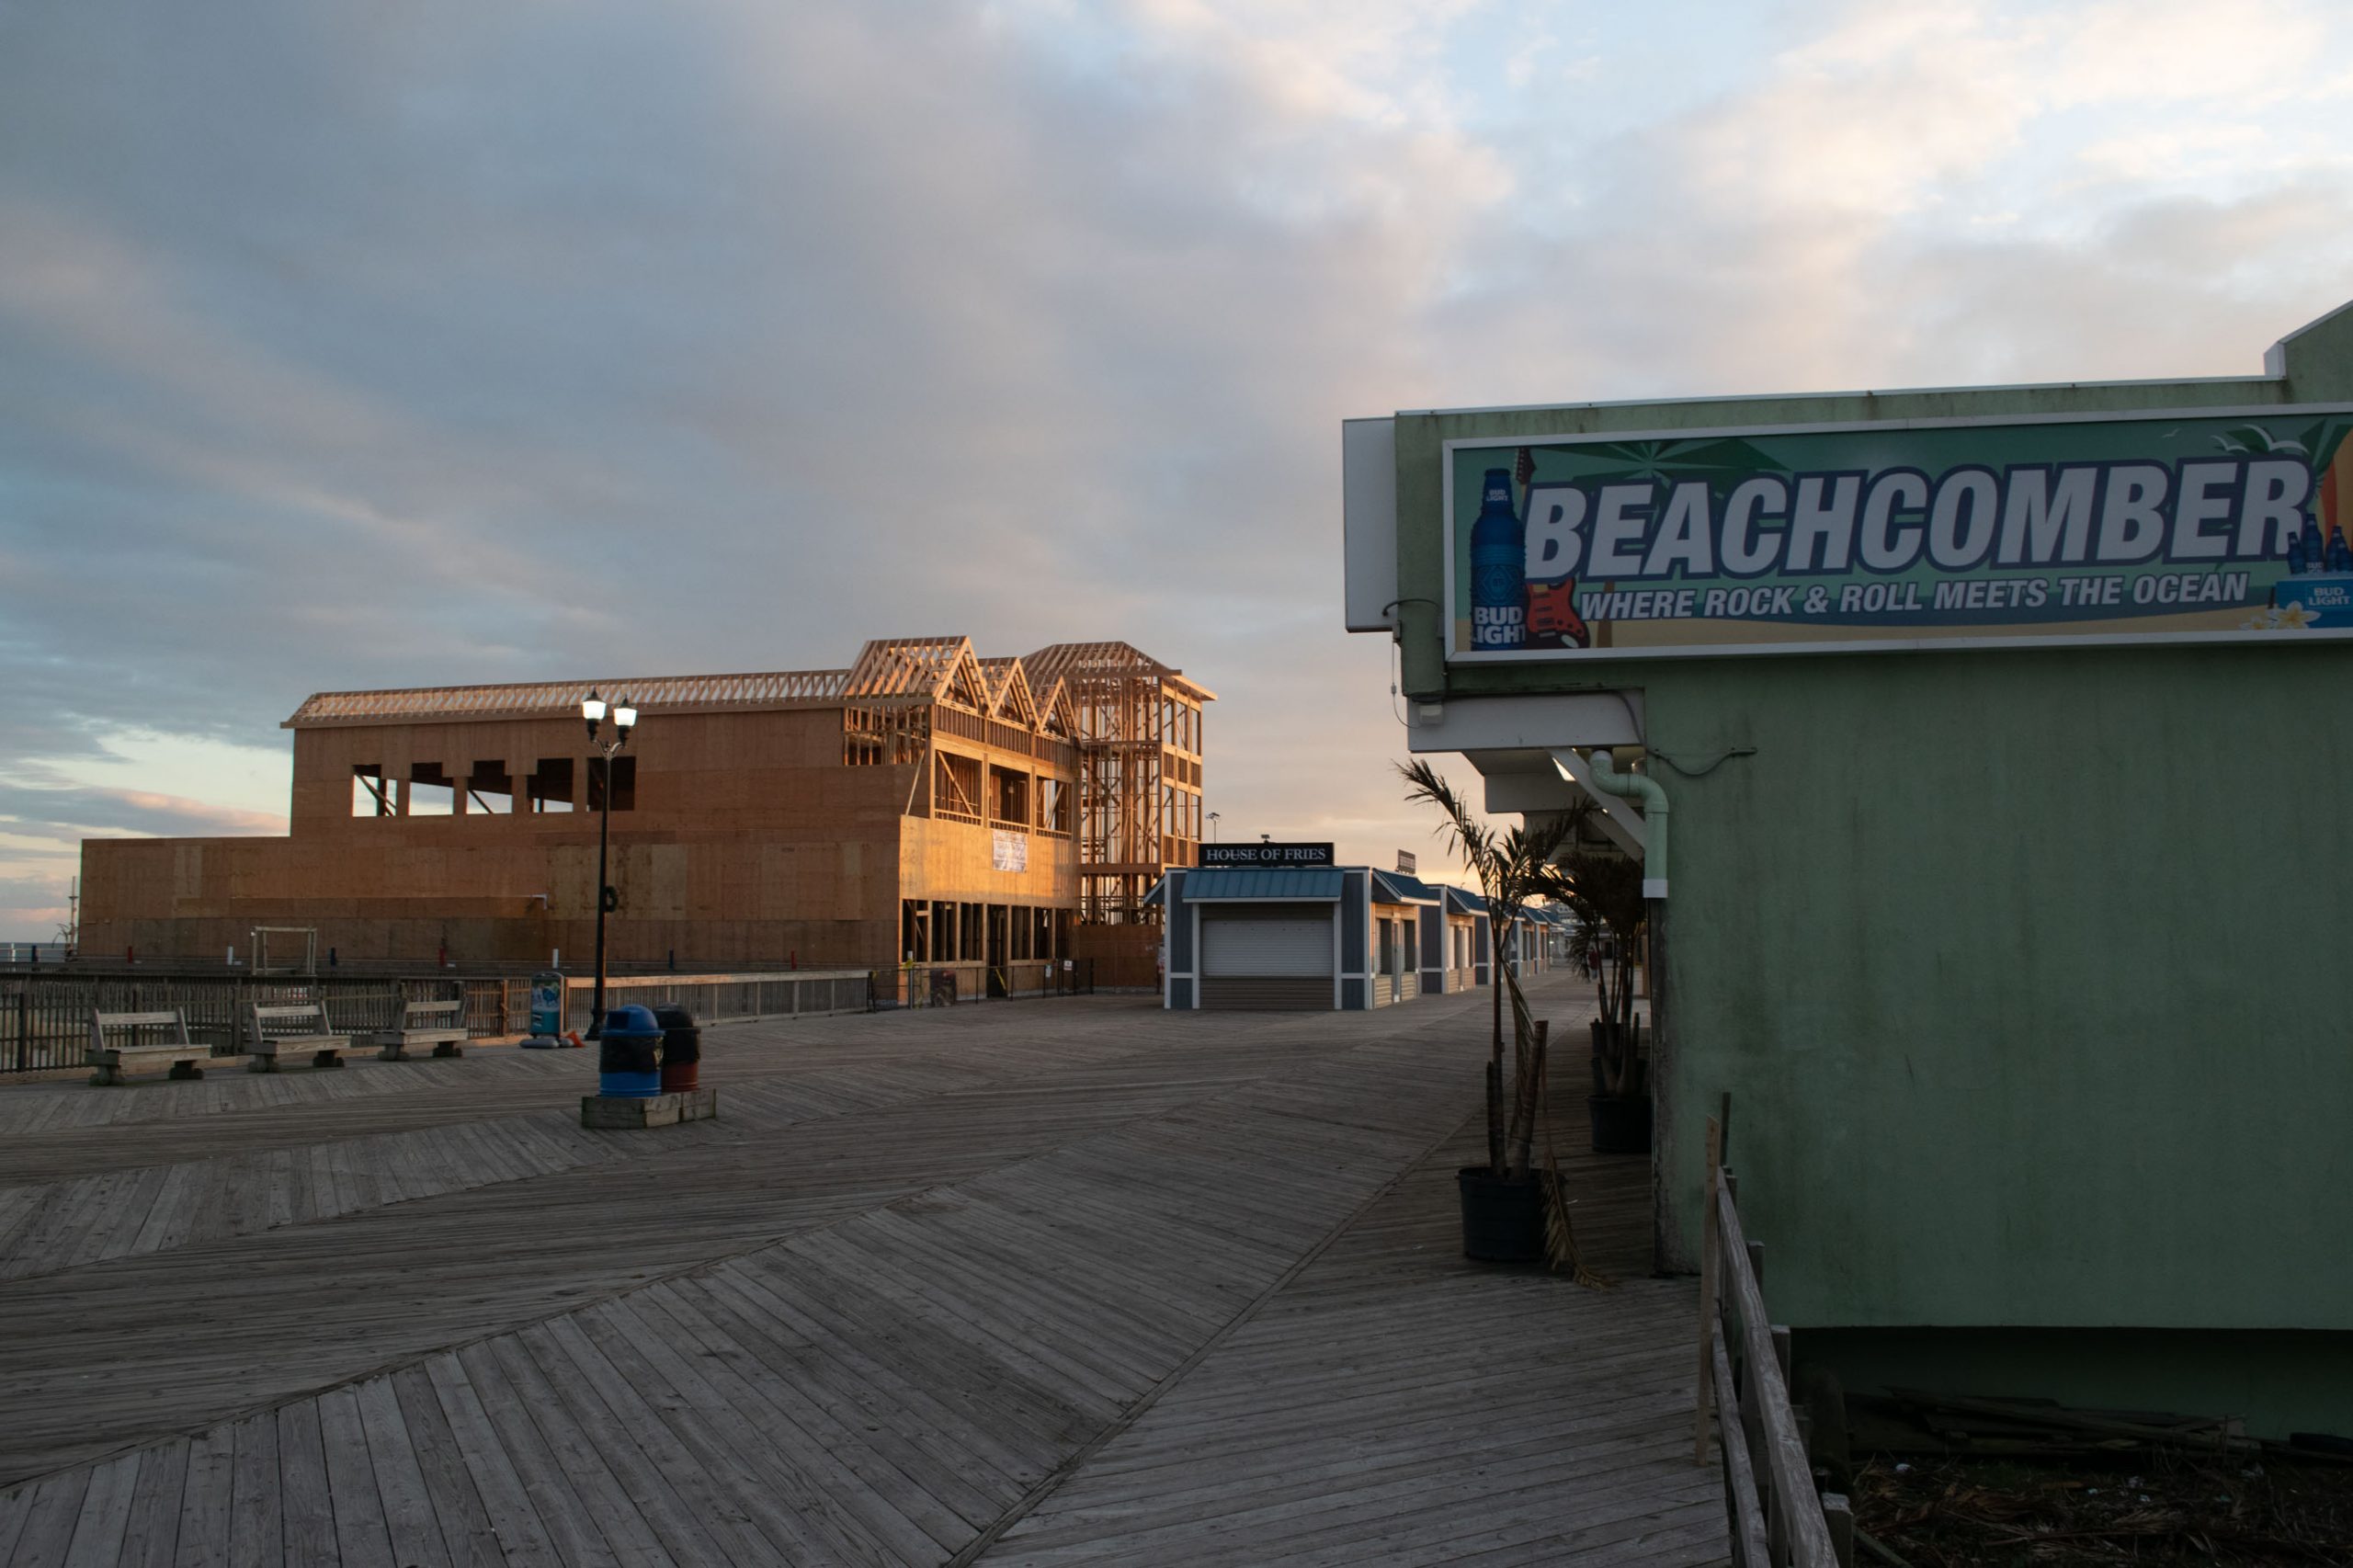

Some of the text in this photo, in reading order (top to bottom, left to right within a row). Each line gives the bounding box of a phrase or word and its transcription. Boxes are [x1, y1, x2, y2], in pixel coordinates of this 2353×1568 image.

[1524, 459, 2310, 579] BEACHCOMBER
[1580, 573, 2248, 620] WHERE ROCK & ROLL MEETS THE OCEAN
[2313, 586, 2345, 597] BUD
[2308, 596, 2351, 606] LIGHT
[1473, 607, 1523, 625] BUD
[1206, 847, 1326, 860] HOUSE OF FRIES
